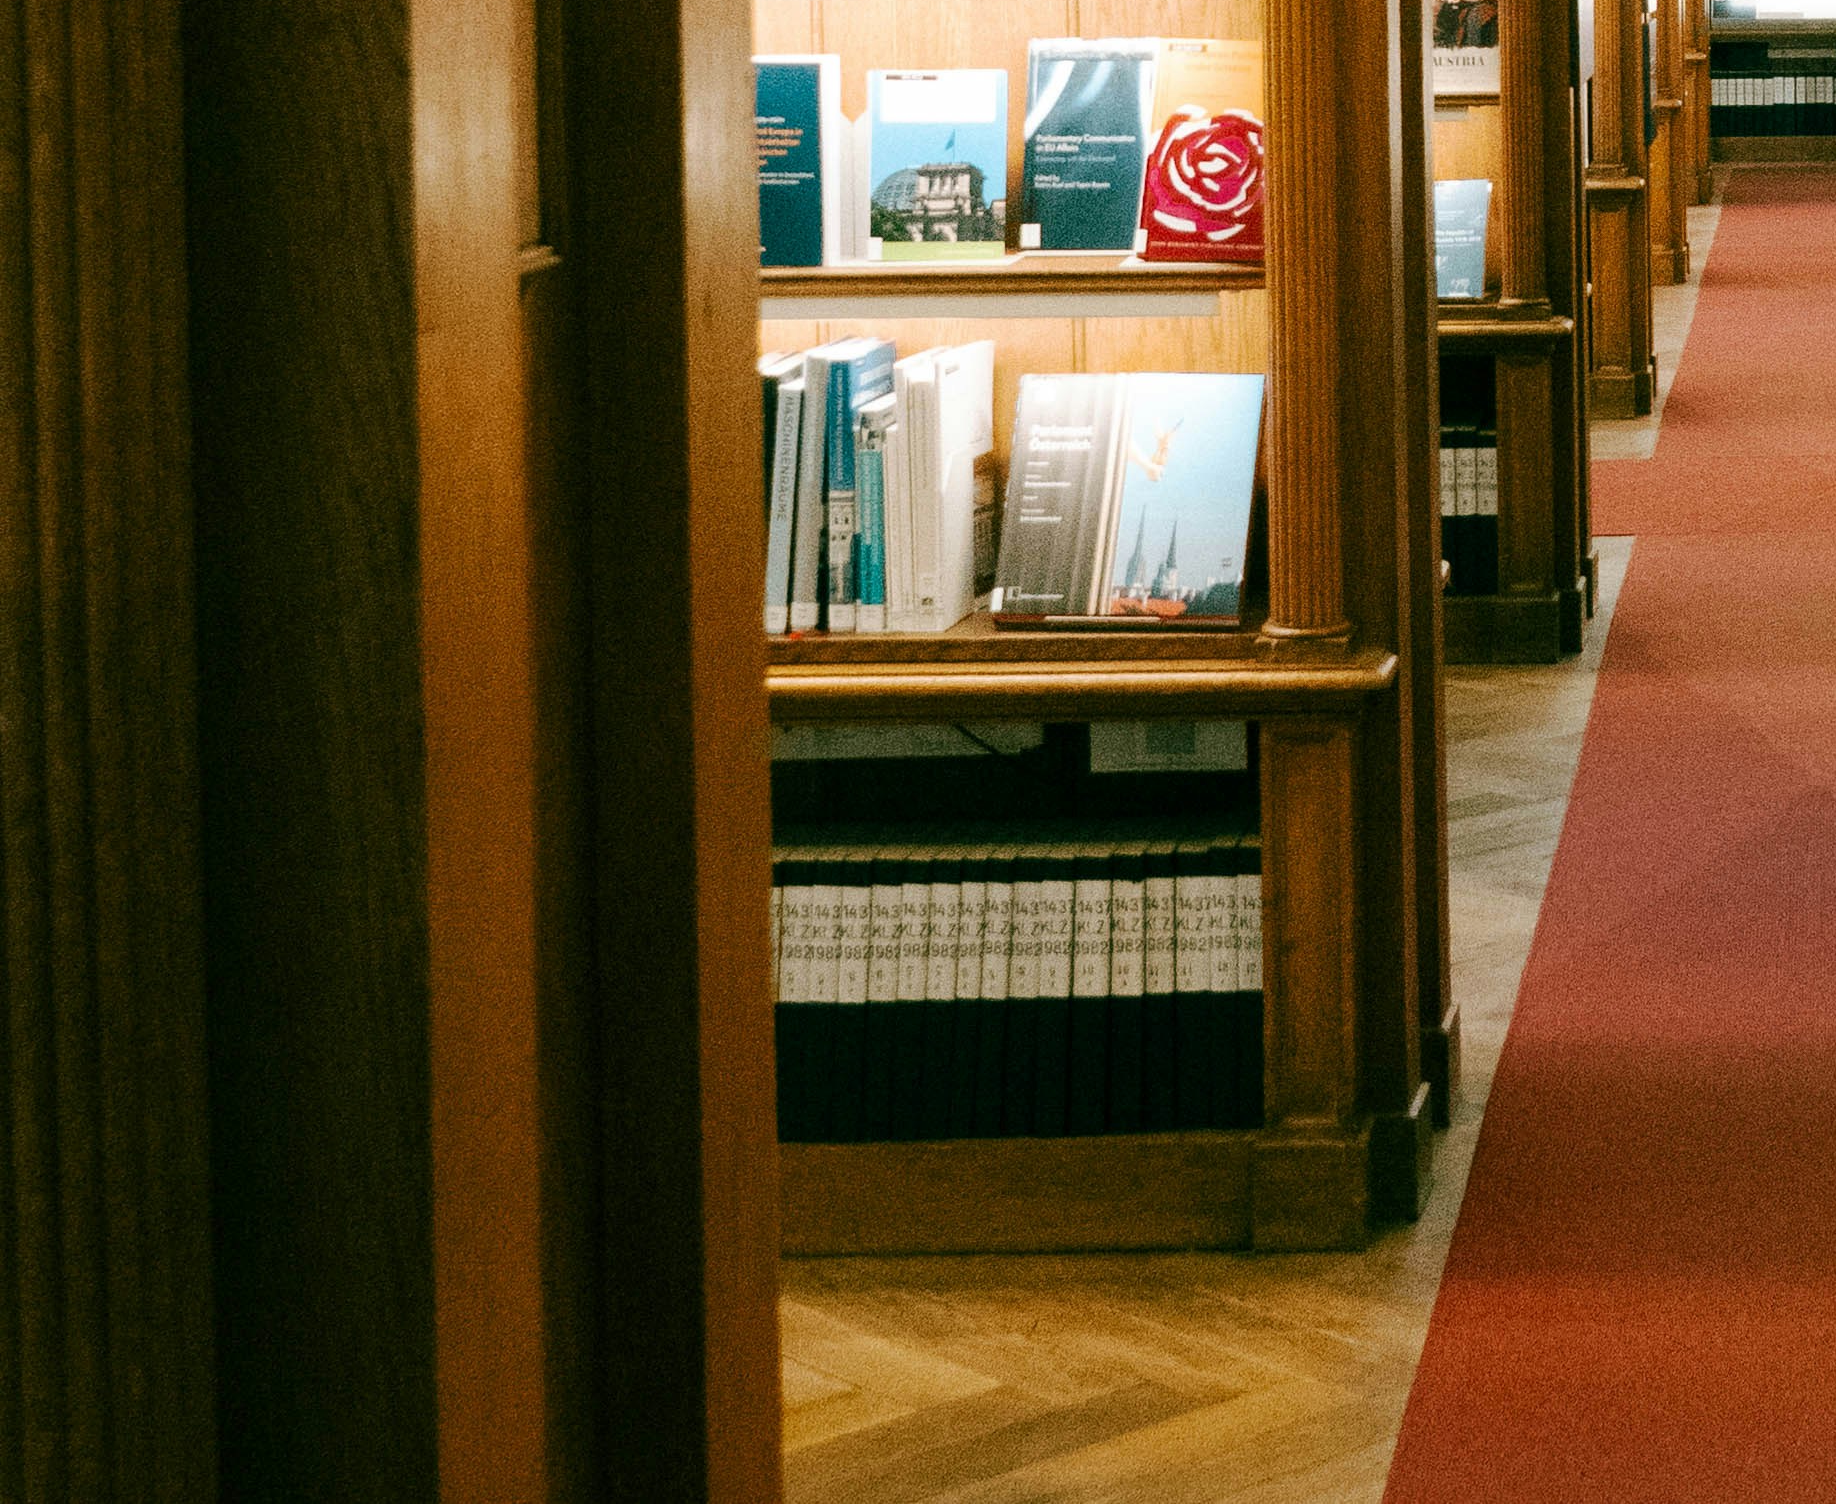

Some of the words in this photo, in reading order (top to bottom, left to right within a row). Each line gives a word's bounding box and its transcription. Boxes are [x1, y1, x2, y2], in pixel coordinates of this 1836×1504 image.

[1035, 134, 1083, 144] Parliamentary
[1044, 143, 1054, 152] EU
[1028, 437, 1093, 452] Österreich
